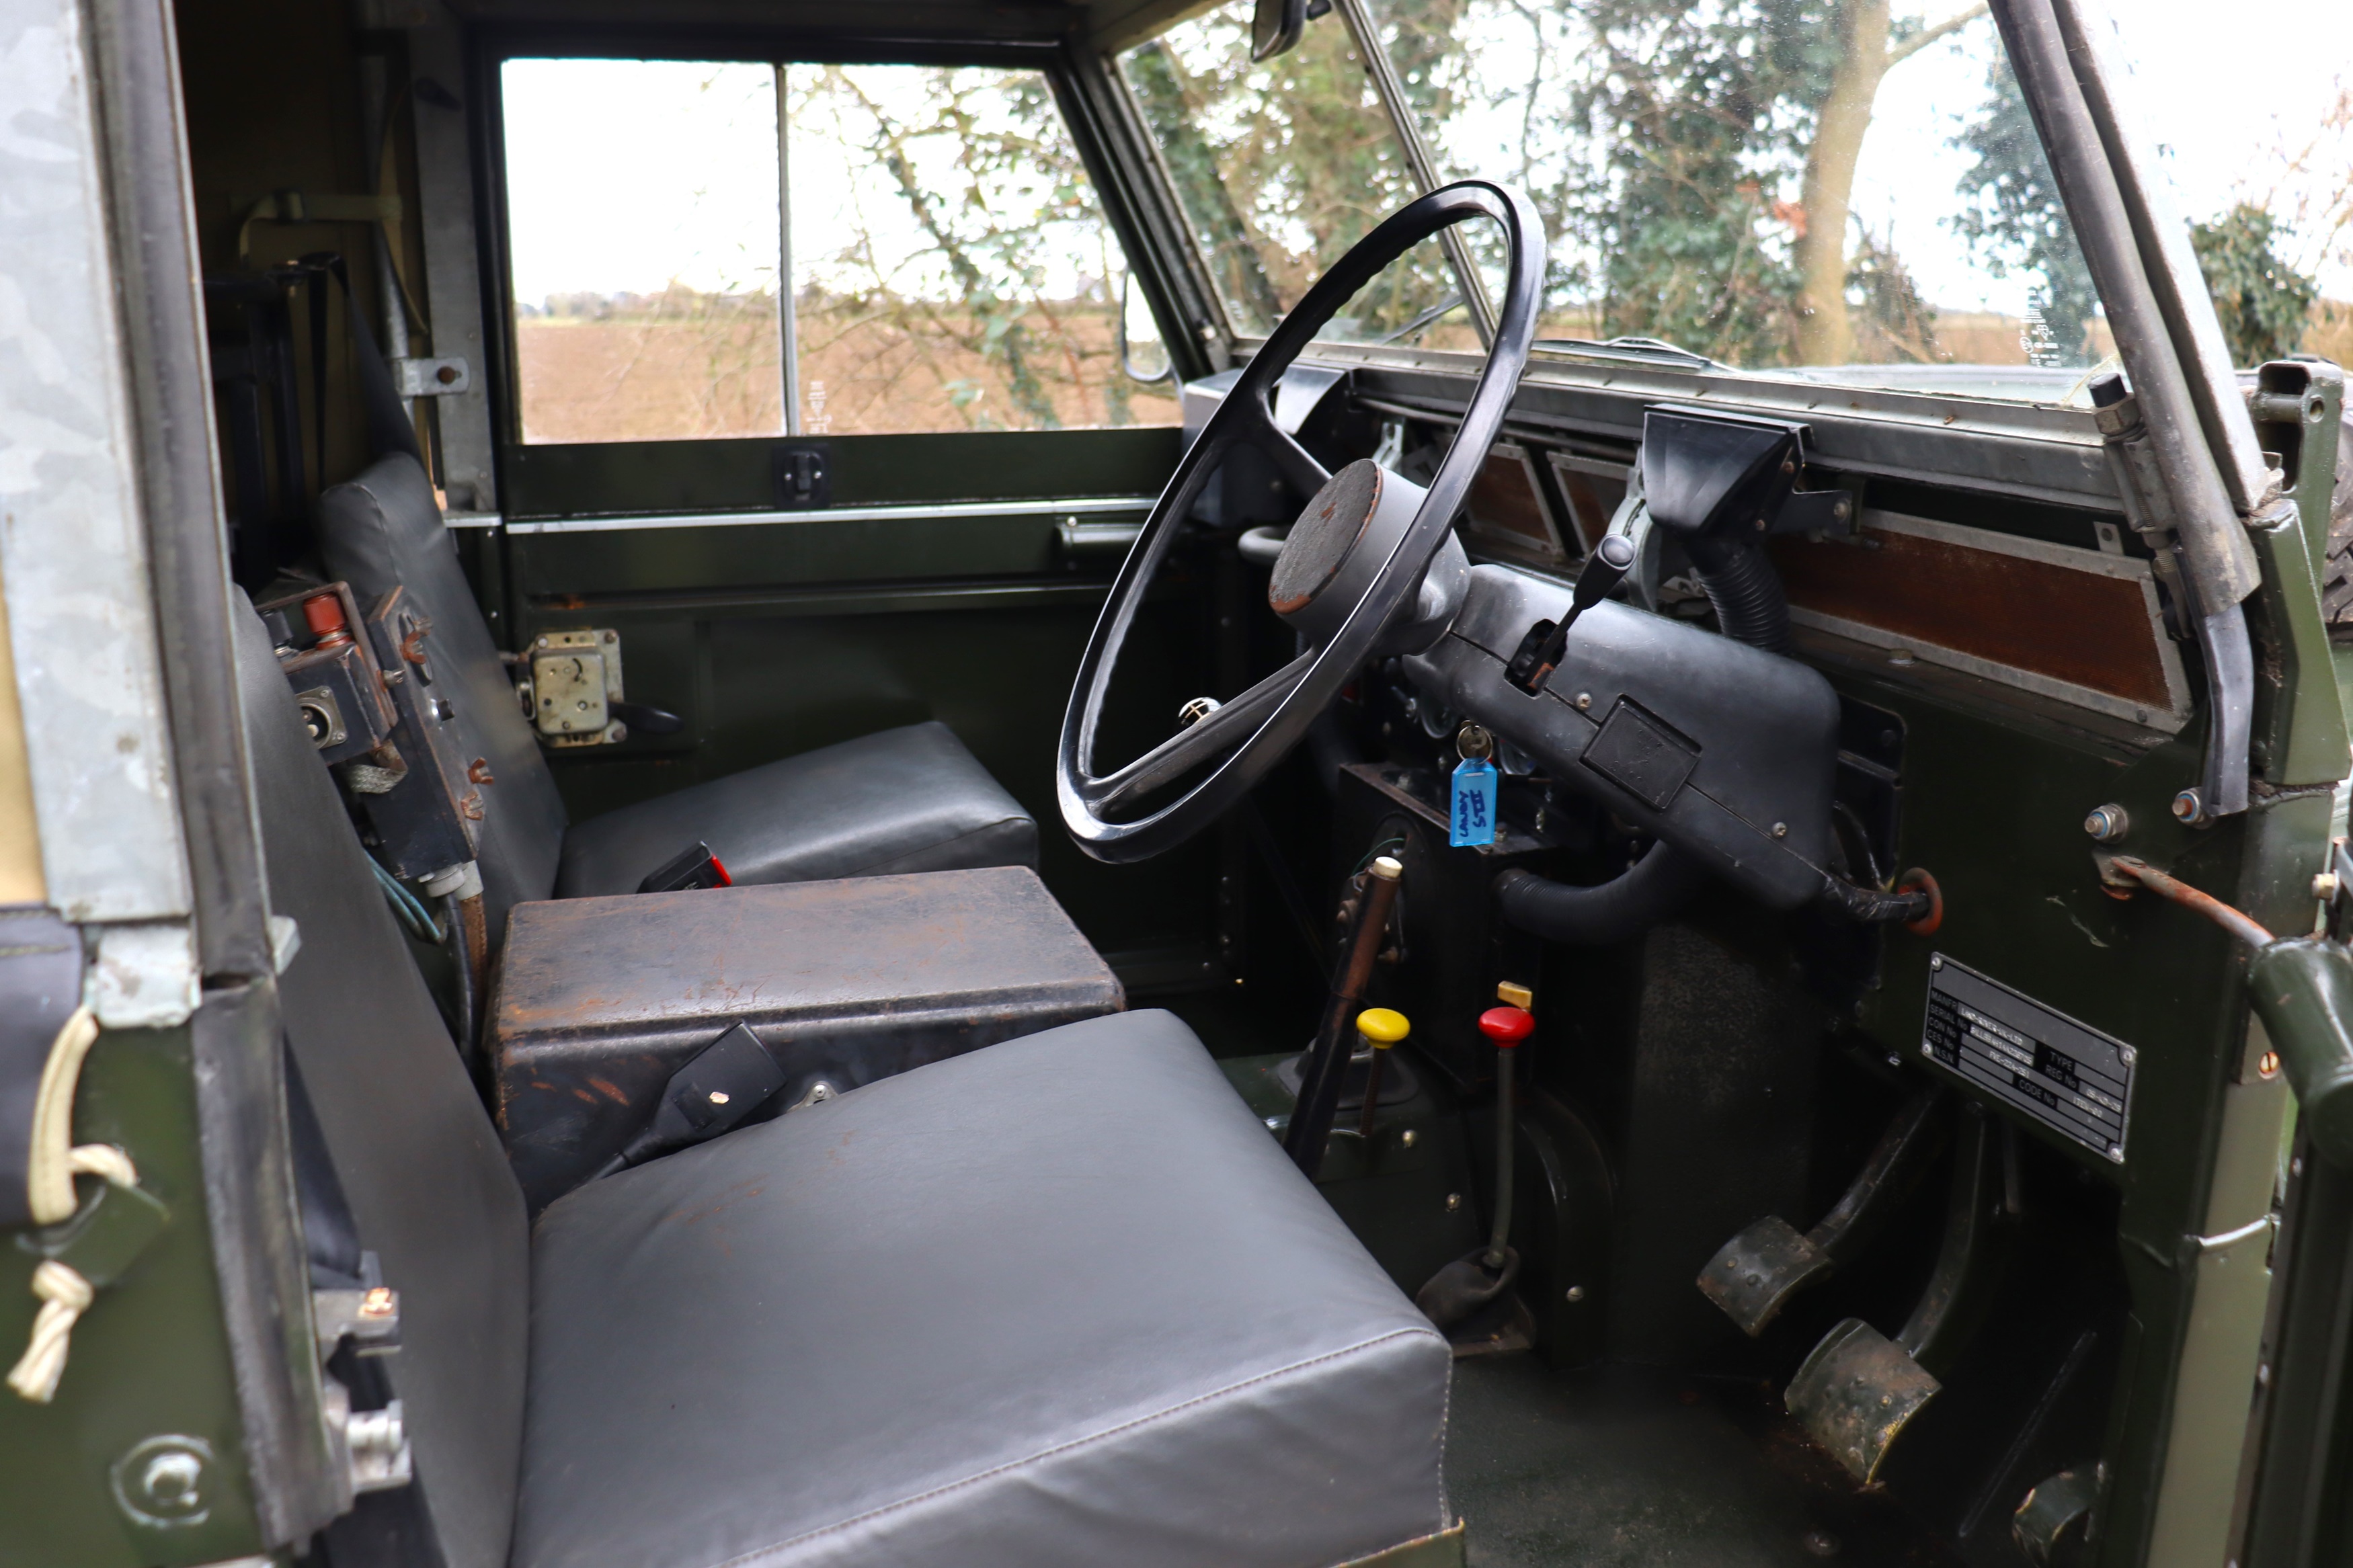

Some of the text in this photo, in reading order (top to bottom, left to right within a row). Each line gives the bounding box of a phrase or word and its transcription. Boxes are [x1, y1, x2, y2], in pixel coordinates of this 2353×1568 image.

[1931, 989, 1957, 1011] MANFR
[1927, 1015, 1945, 1033] CON
[1946, 1024, 1957, 1039] No
[1929, 1002, 1956, 1025] SERIAL
[1956, 1017, 1968, 1031] No
[1926, 1027, 1954, 1051] CES No
[2049, 1050, 2073, 1071] TYPE
[2045, 1063, 2063, 1081] REG
[2064, 1073, 2077, 1089] No
[2018, 1077, 2055, 1106] CODE No
